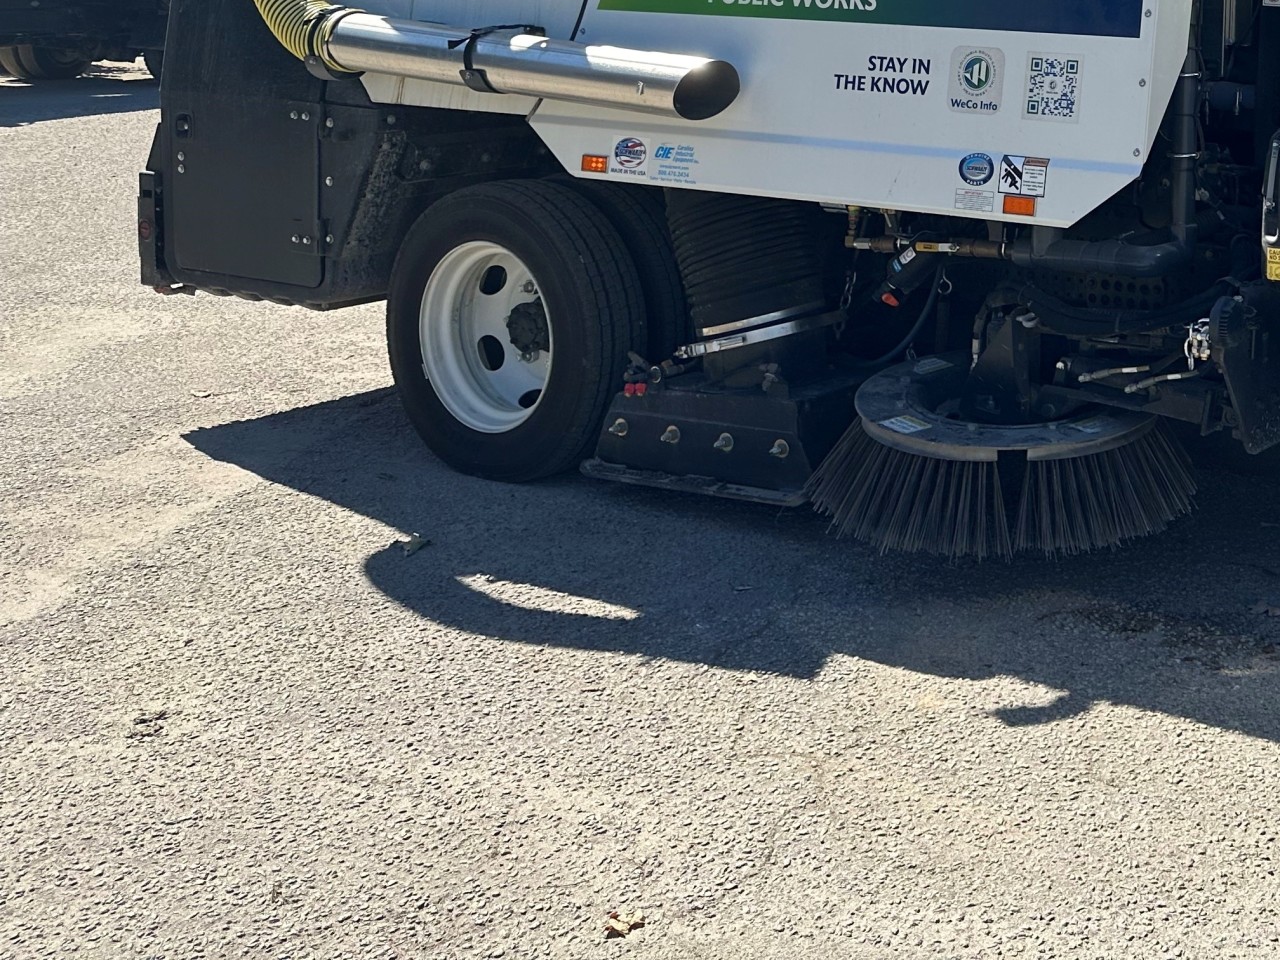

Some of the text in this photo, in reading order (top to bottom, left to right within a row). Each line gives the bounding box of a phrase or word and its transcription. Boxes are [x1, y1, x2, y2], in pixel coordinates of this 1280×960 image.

[868, 55, 931, 75] STAY IN
[834, 74, 930, 96] THE KNOW
[950, 98, 998, 111] WeCo Info
[655, 146, 675, 159] CIE
